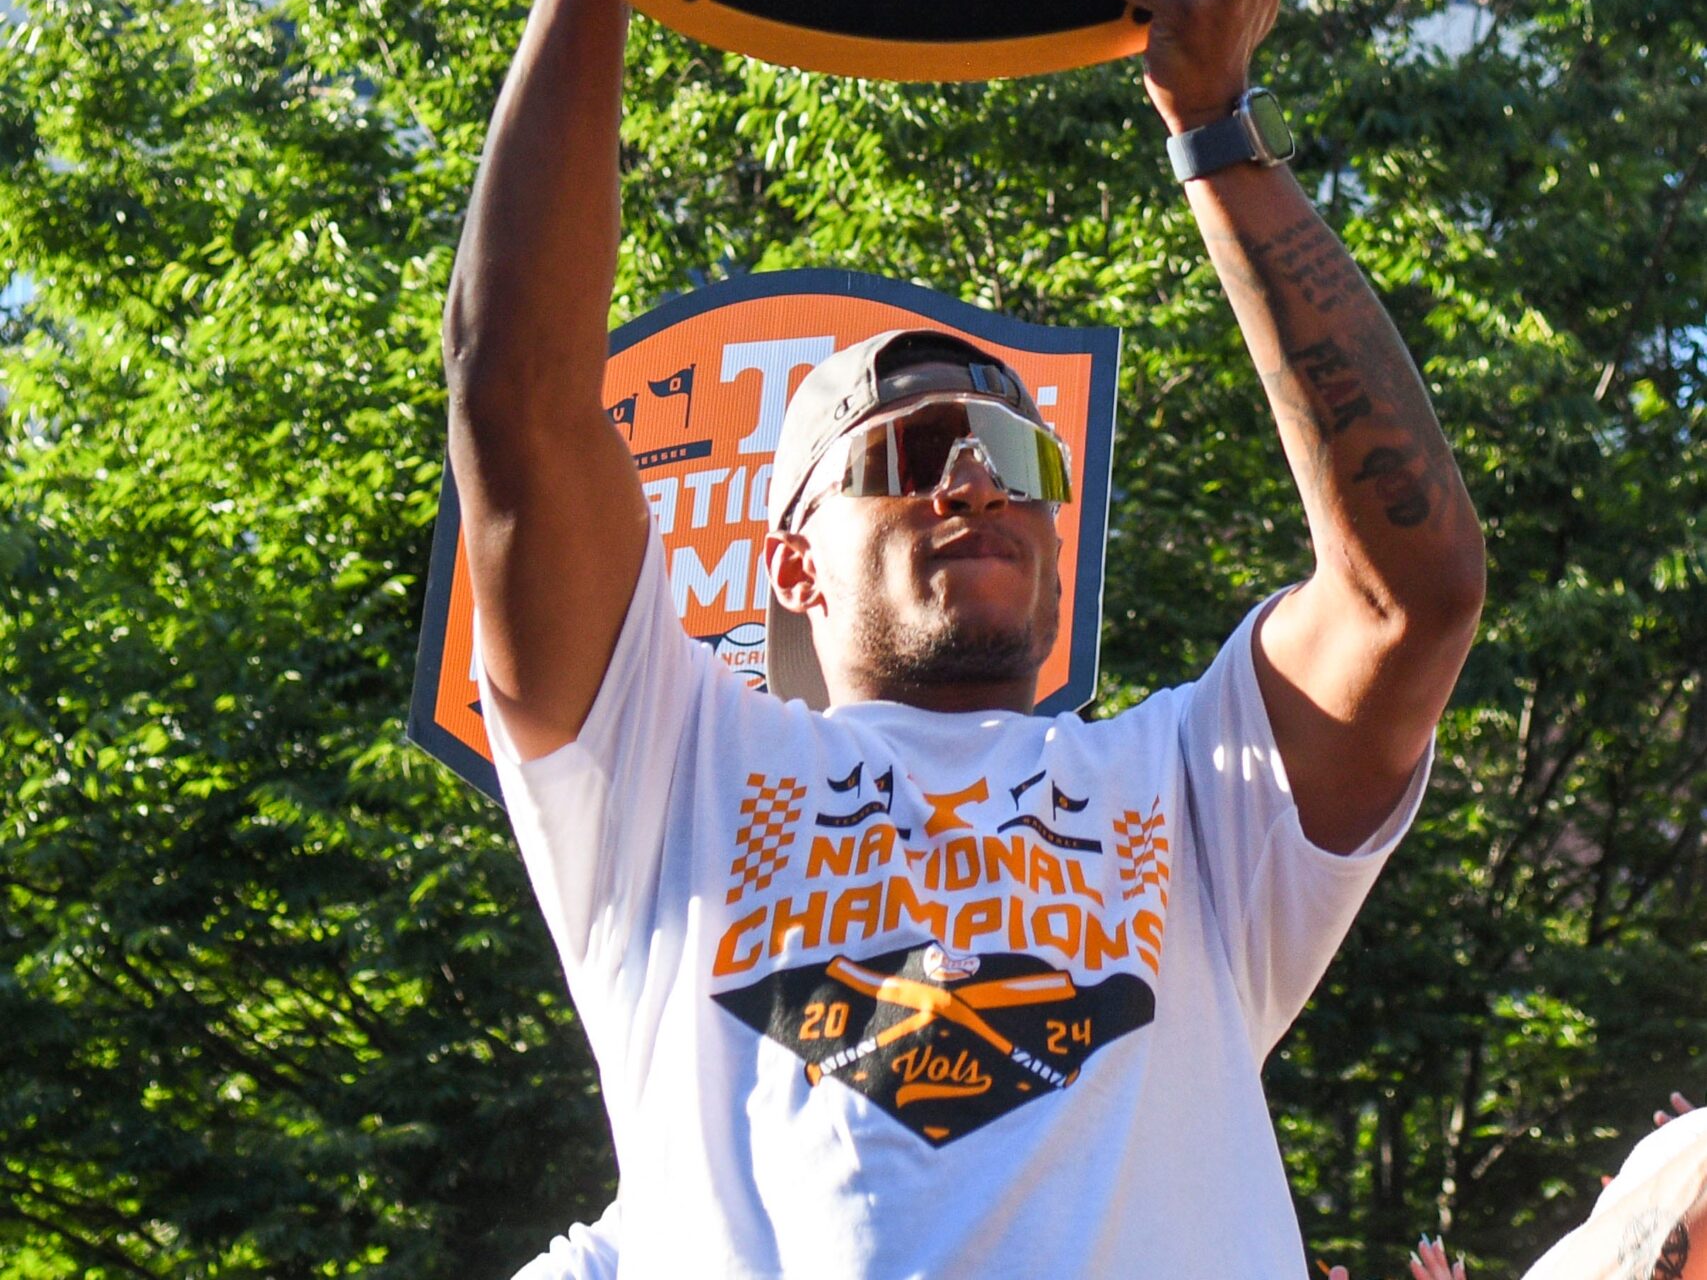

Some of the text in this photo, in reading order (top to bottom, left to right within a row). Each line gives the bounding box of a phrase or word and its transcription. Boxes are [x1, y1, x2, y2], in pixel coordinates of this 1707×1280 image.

[712, 876, 1164, 977] CHAMPIONS
[799, 1002, 1092, 1055] 20 24
[892, 1046, 992, 1100] Vols
